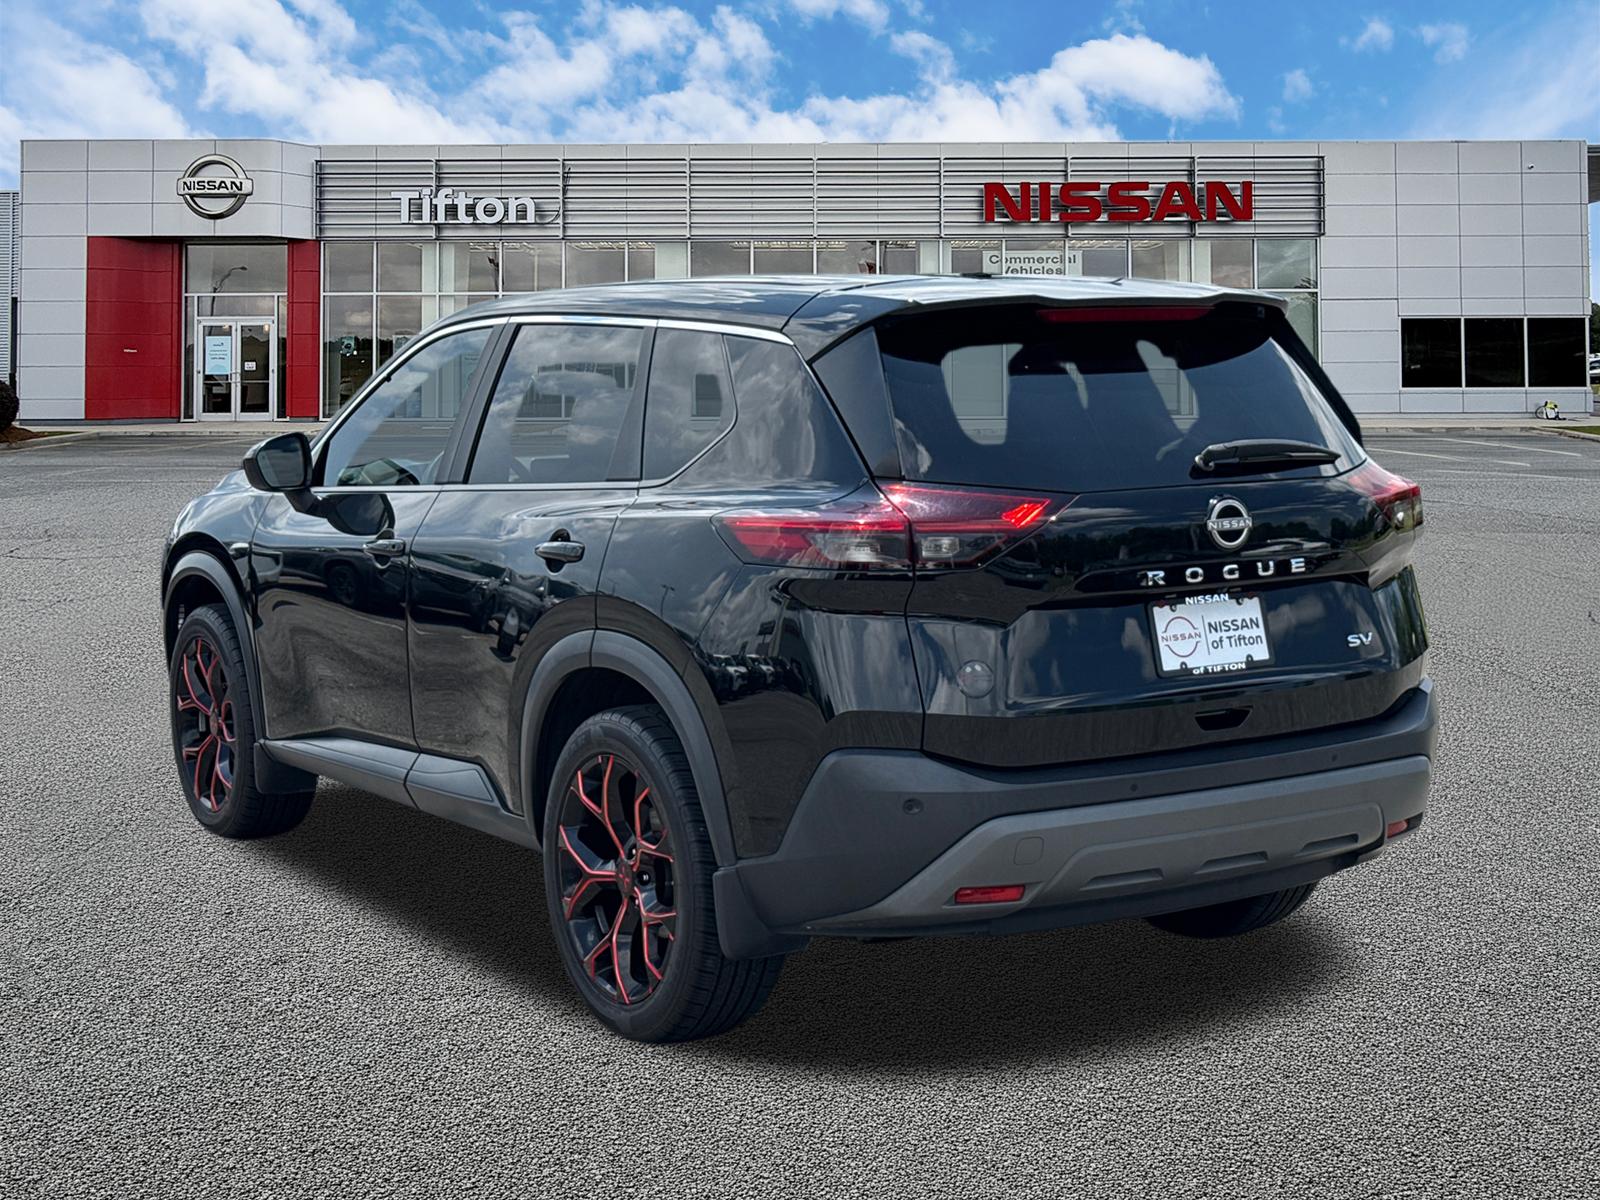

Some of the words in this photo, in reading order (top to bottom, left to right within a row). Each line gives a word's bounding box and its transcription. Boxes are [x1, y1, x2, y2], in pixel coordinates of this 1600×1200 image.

[182, 180, 243, 191] NISSAN
[391, 188, 536, 223] Tifton
[983, 180, 1254, 223] NISSAN
[1209, 519, 1252, 529] NISSAN
[1146, 557, 1306, 586] ROGUE
[1185, 593, 1229, 605] NISSAN
[1208, 617, 1260, 634] NISSAN
[1161, 631, 1202, 643] NISSAN
[1211, 636, 1224, 650] of
[1226, 634, 1264, 649] Tifton
[1347, 632, 1373, 648] SV
[1192, 667, 1205, 675] of
[1206, 662, 1247, 673] TIFTON
